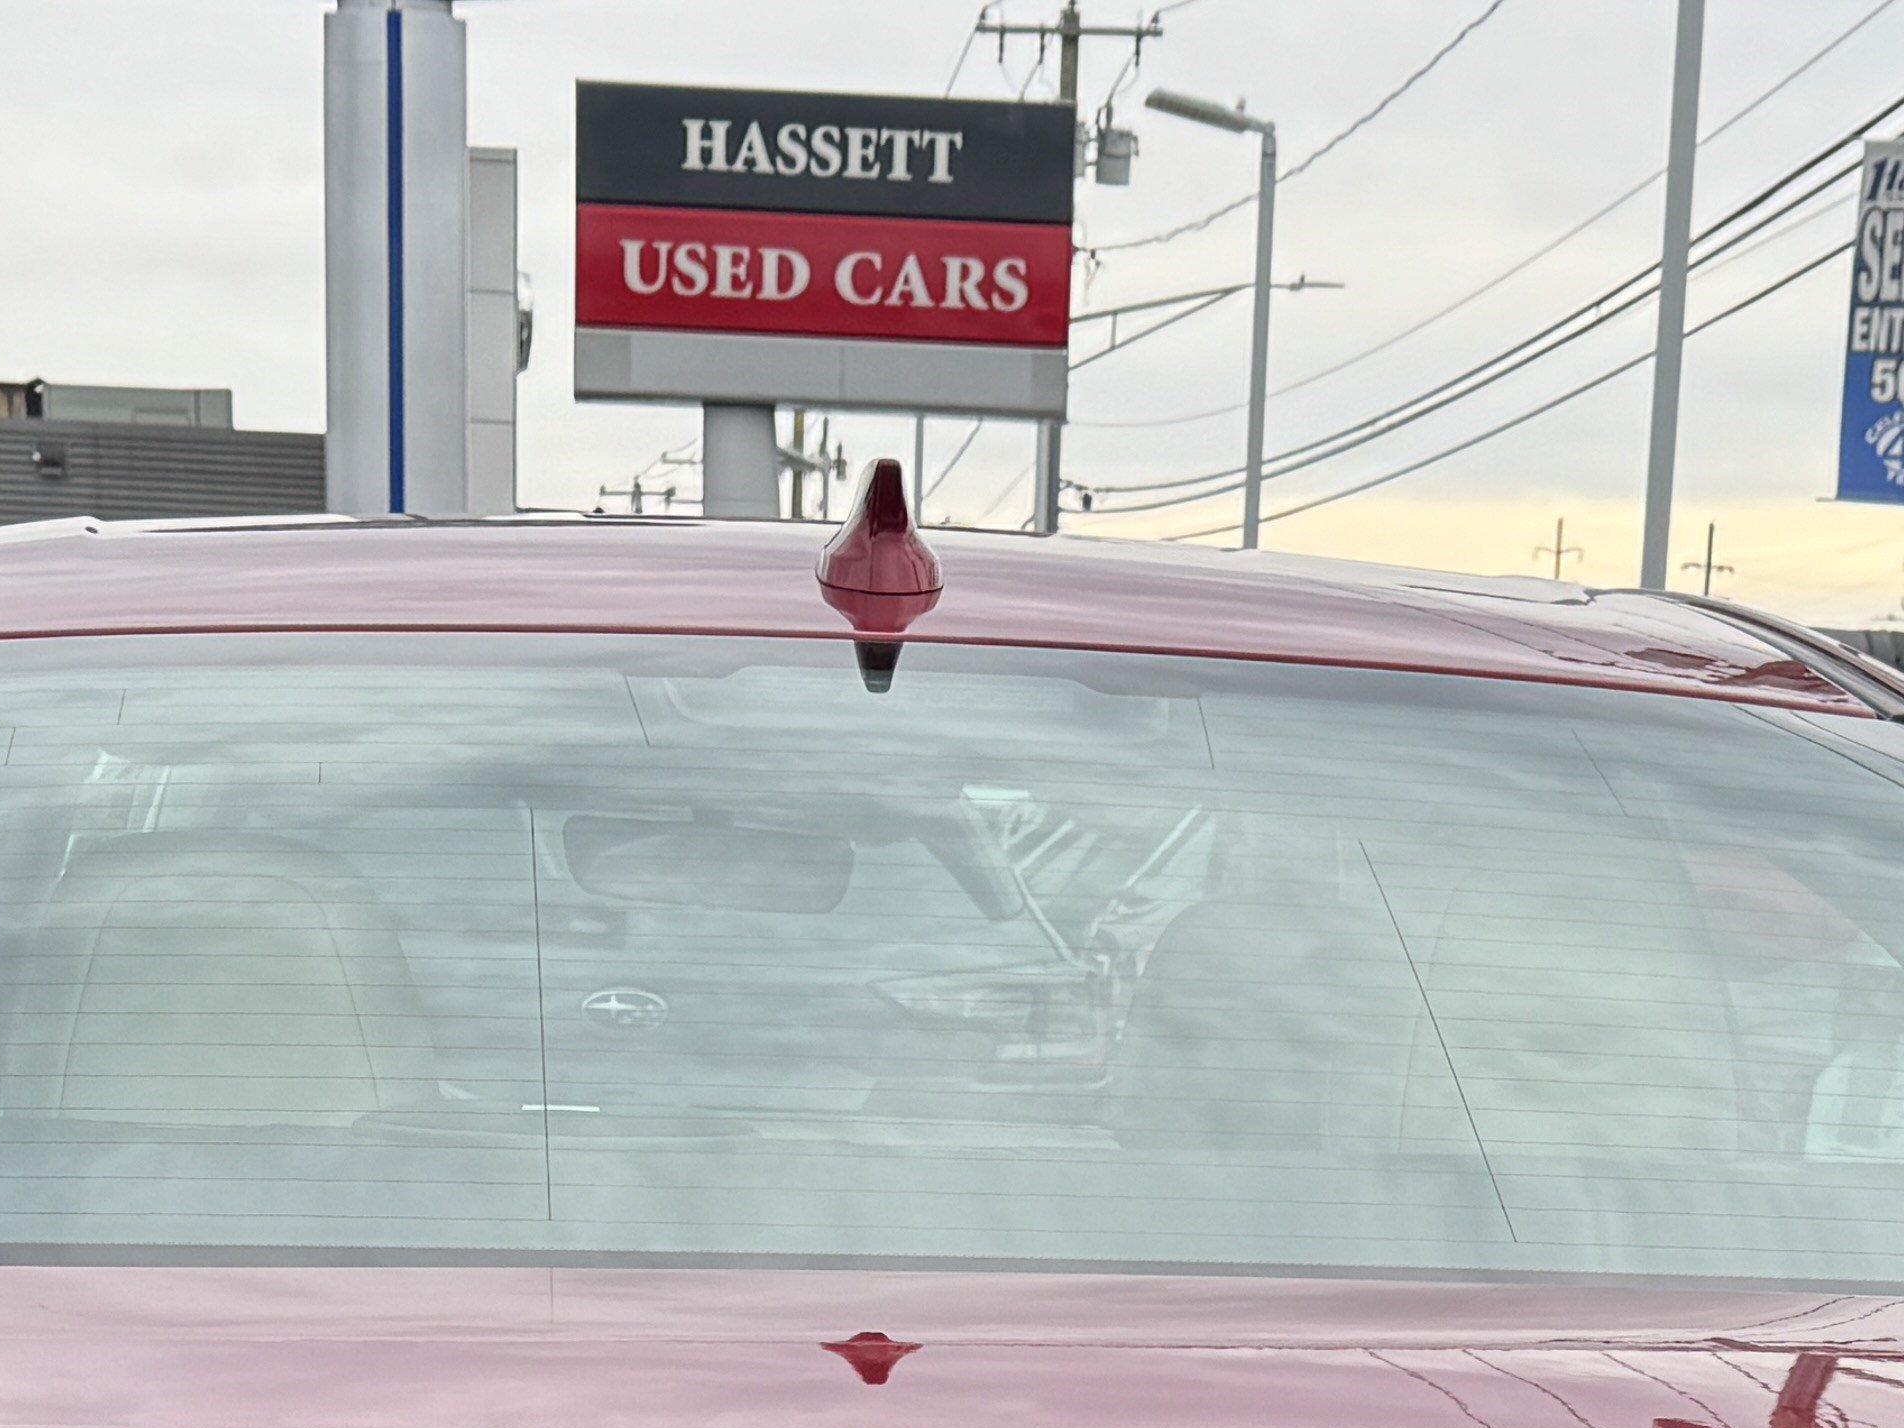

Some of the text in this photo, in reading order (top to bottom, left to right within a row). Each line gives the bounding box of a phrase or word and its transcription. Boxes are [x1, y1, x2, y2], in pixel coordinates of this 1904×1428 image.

[682, 119, 963, 184] HASSETT
[620, 239, 1029, 312] USED CARS
